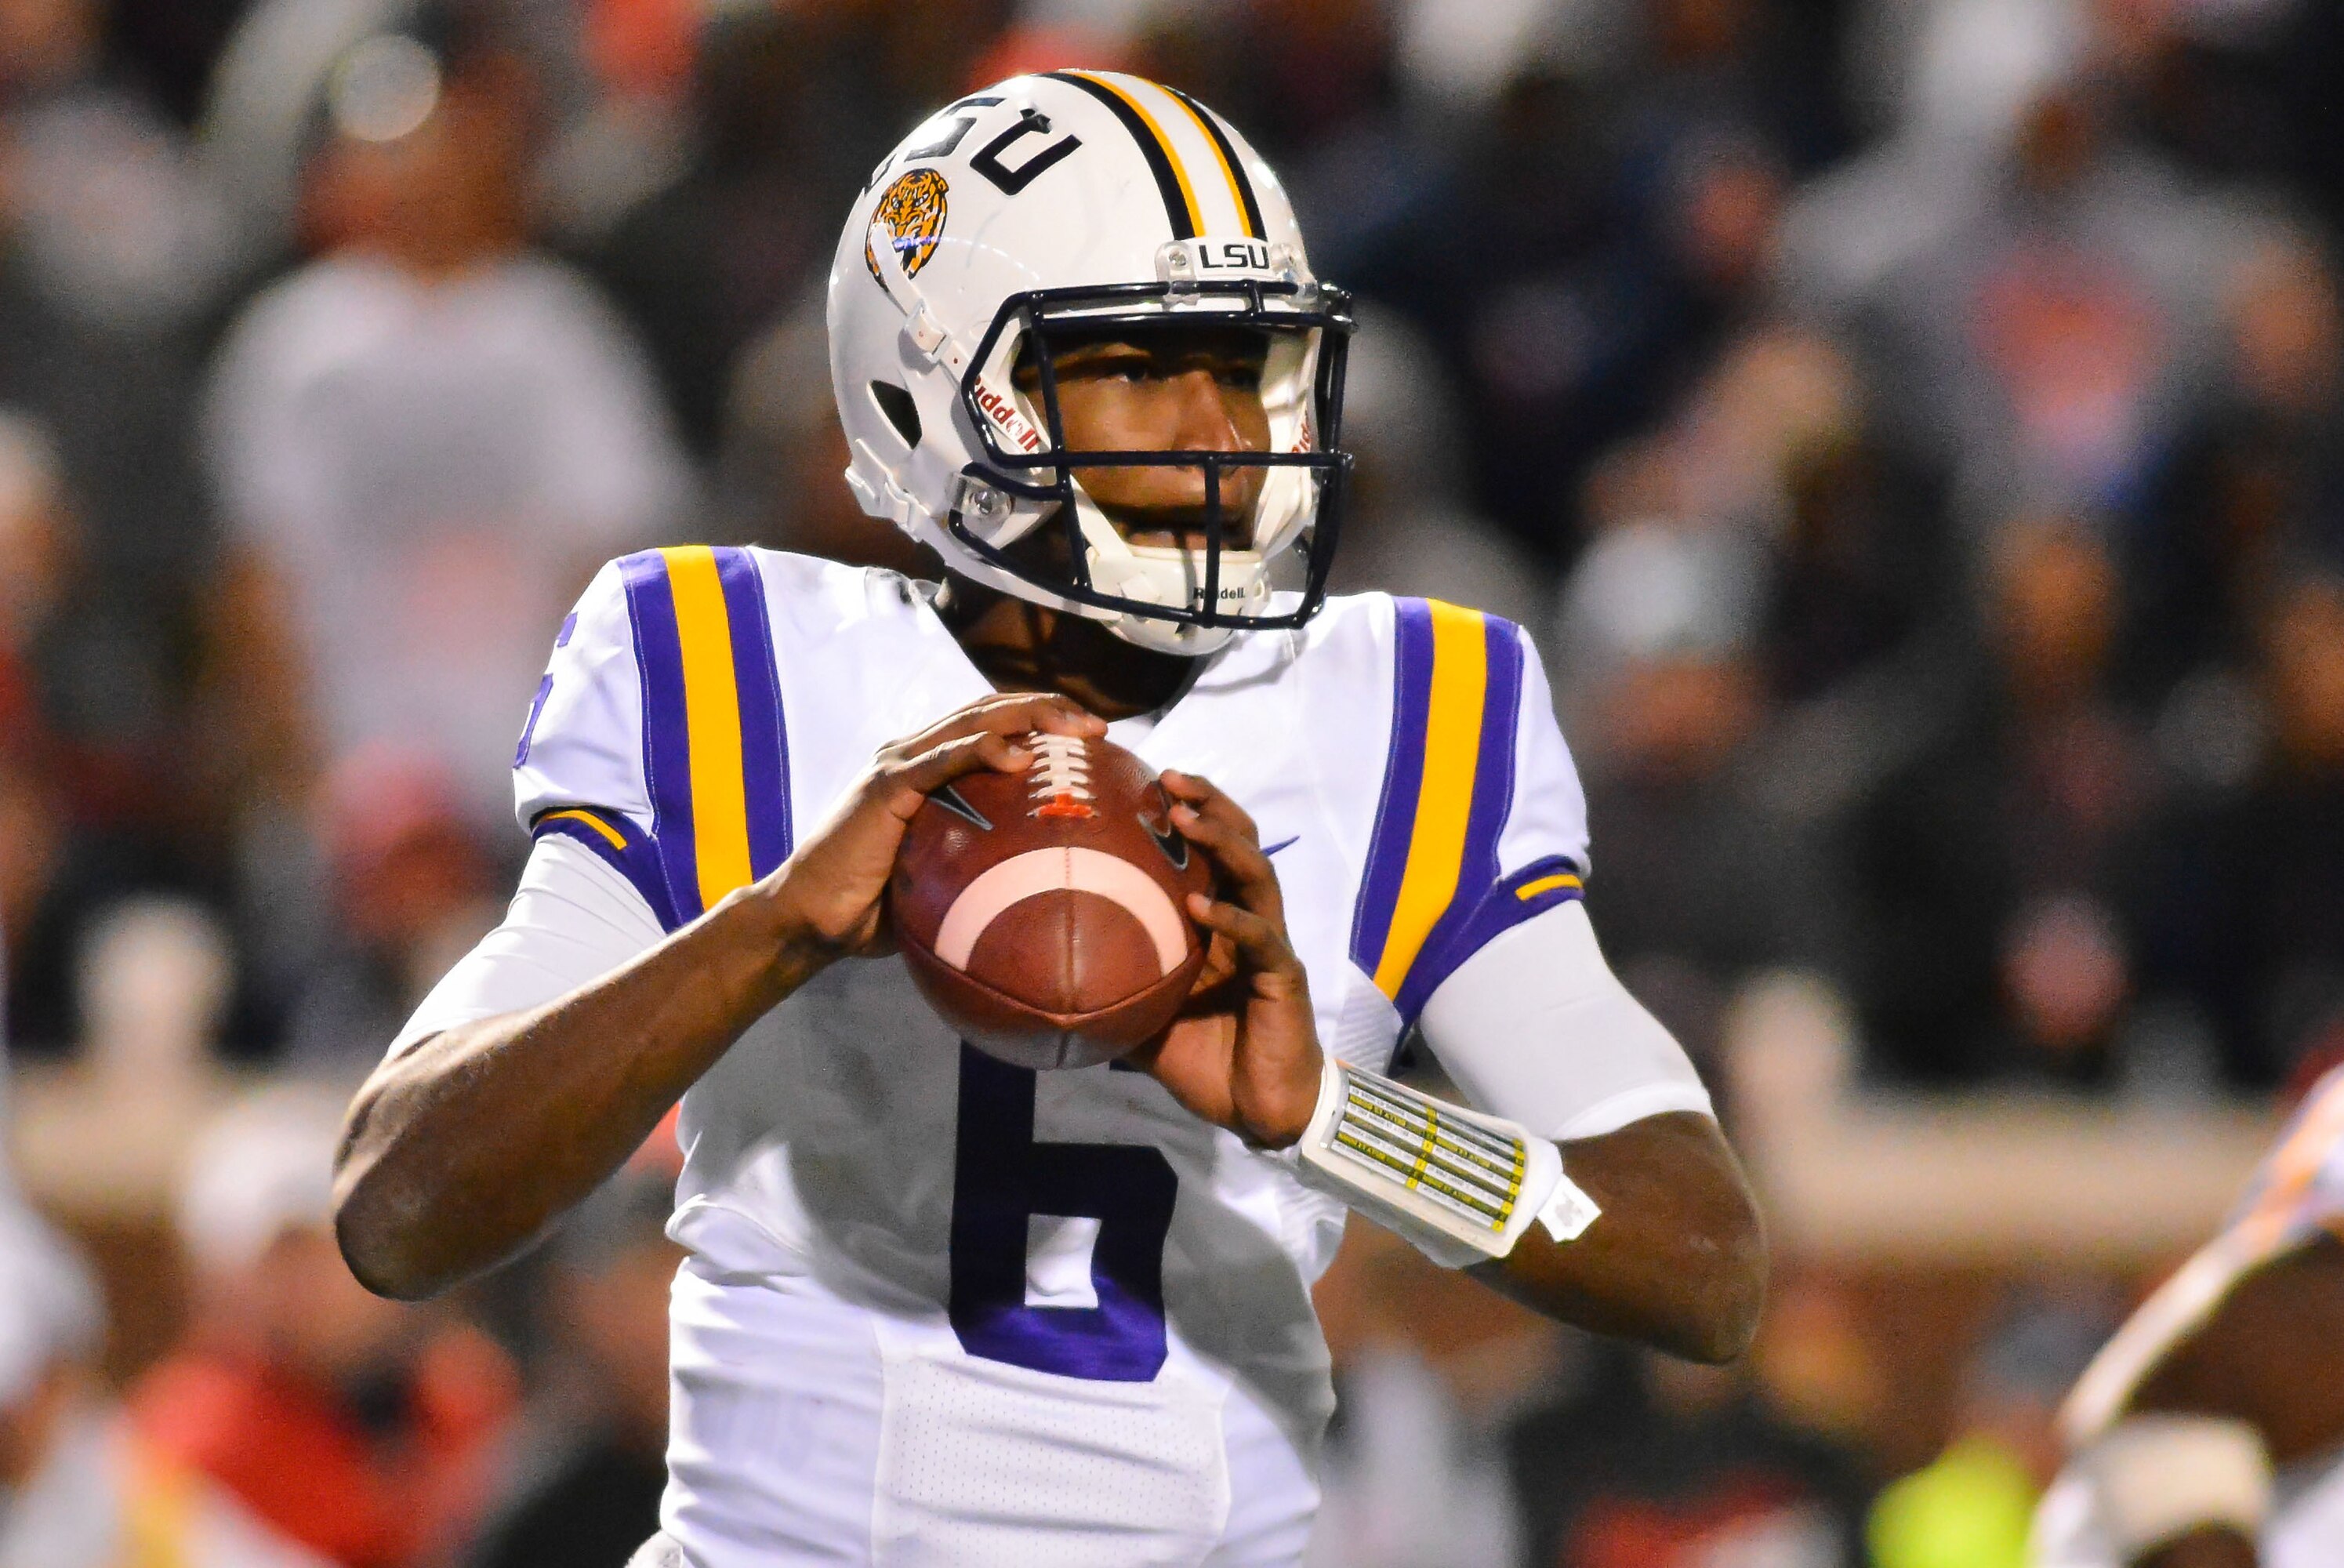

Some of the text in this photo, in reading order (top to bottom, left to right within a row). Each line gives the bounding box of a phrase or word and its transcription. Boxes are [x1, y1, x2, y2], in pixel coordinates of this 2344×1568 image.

[1199, 245, 1269, 269] LSU
[975, 376, 1040, 452] iddell
[1193, 587, 1244, 599] Rdell
[949, 1040, 1178, 1382] 6
